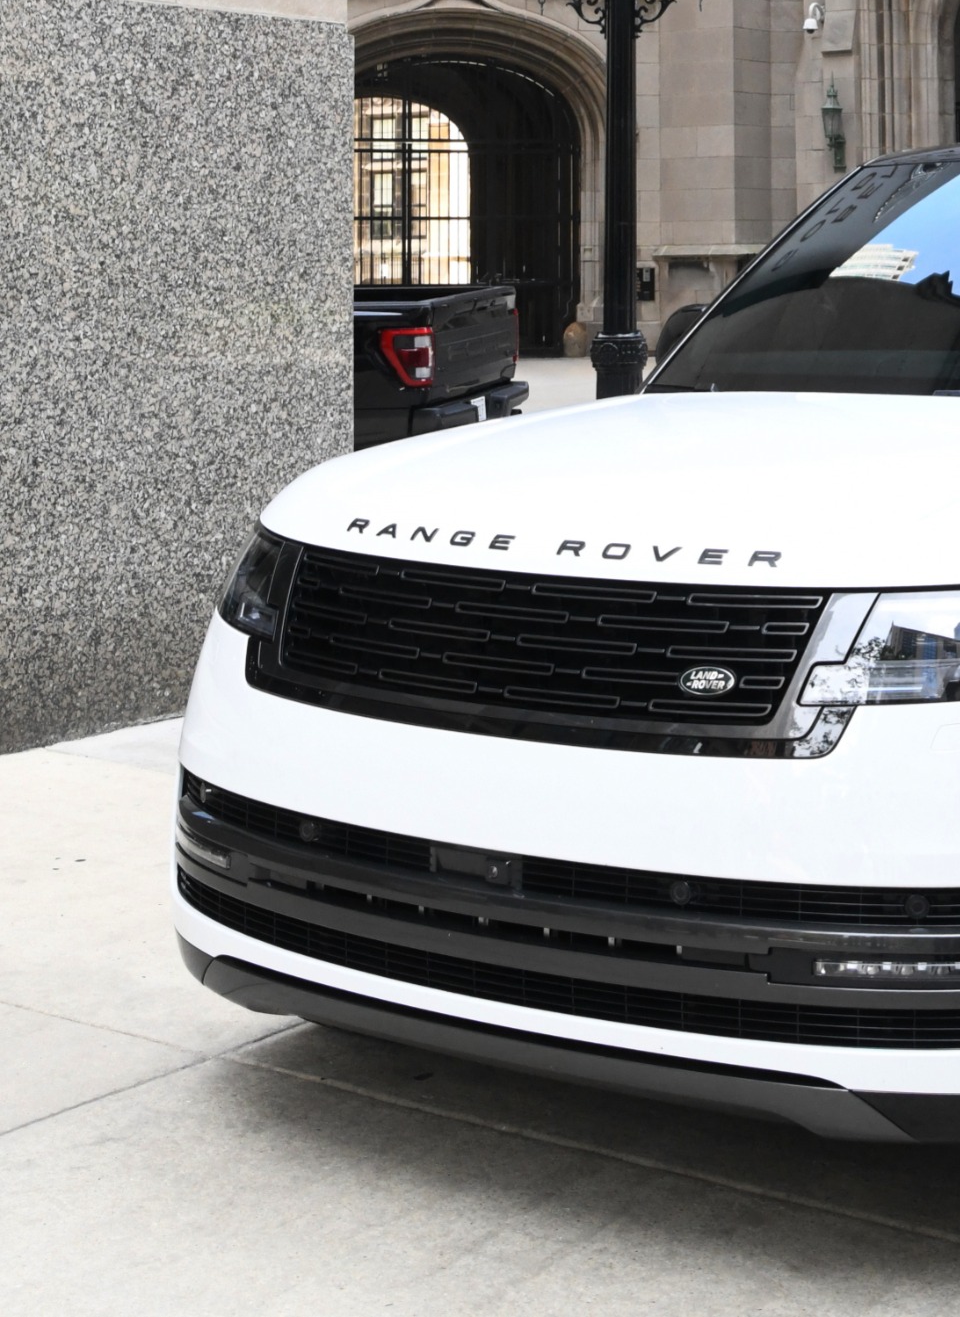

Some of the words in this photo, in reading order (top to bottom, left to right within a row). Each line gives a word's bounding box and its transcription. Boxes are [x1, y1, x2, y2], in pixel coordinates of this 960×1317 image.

[346, 517, 517, 551] RANGE
[556, 539, 785, 568] ROVER
[690, 671, 718, 680] LAND
[691, 680, 726, 689] ROVER
